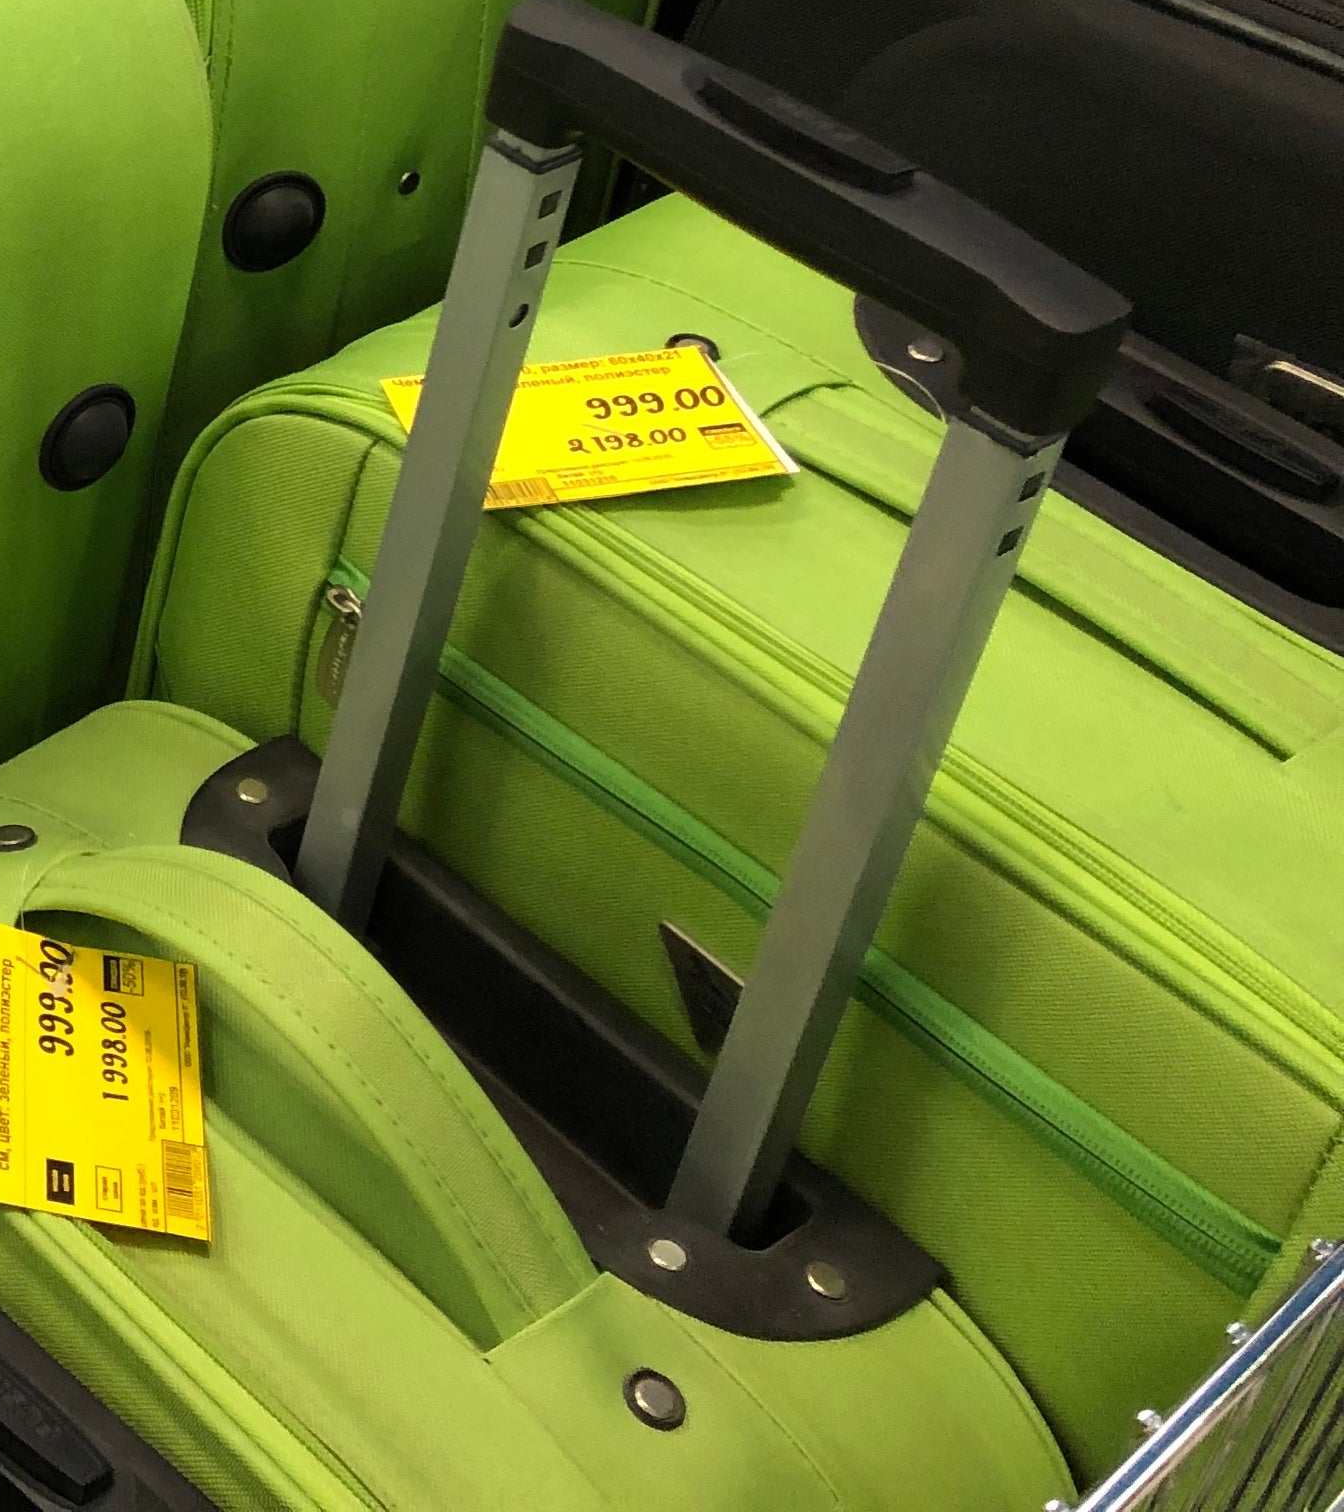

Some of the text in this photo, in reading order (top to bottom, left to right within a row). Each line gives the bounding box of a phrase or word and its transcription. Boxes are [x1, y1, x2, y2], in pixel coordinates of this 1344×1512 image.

[583, 365, 671, 381] полиэстер
[586, 385, 725, 420] 999.00
[591, 427, 687, 452] 198.00
[122, 959, 138, 993] -50%
[0, 958, 14, 1035] полиэстер
[38, 939, 74, 1057] 999.00
[100, 1002, 126, 1084] 998.00
[0, 1039, 13, 1102] зеленый,
[0, 1108, 12, 1142] цвет:
